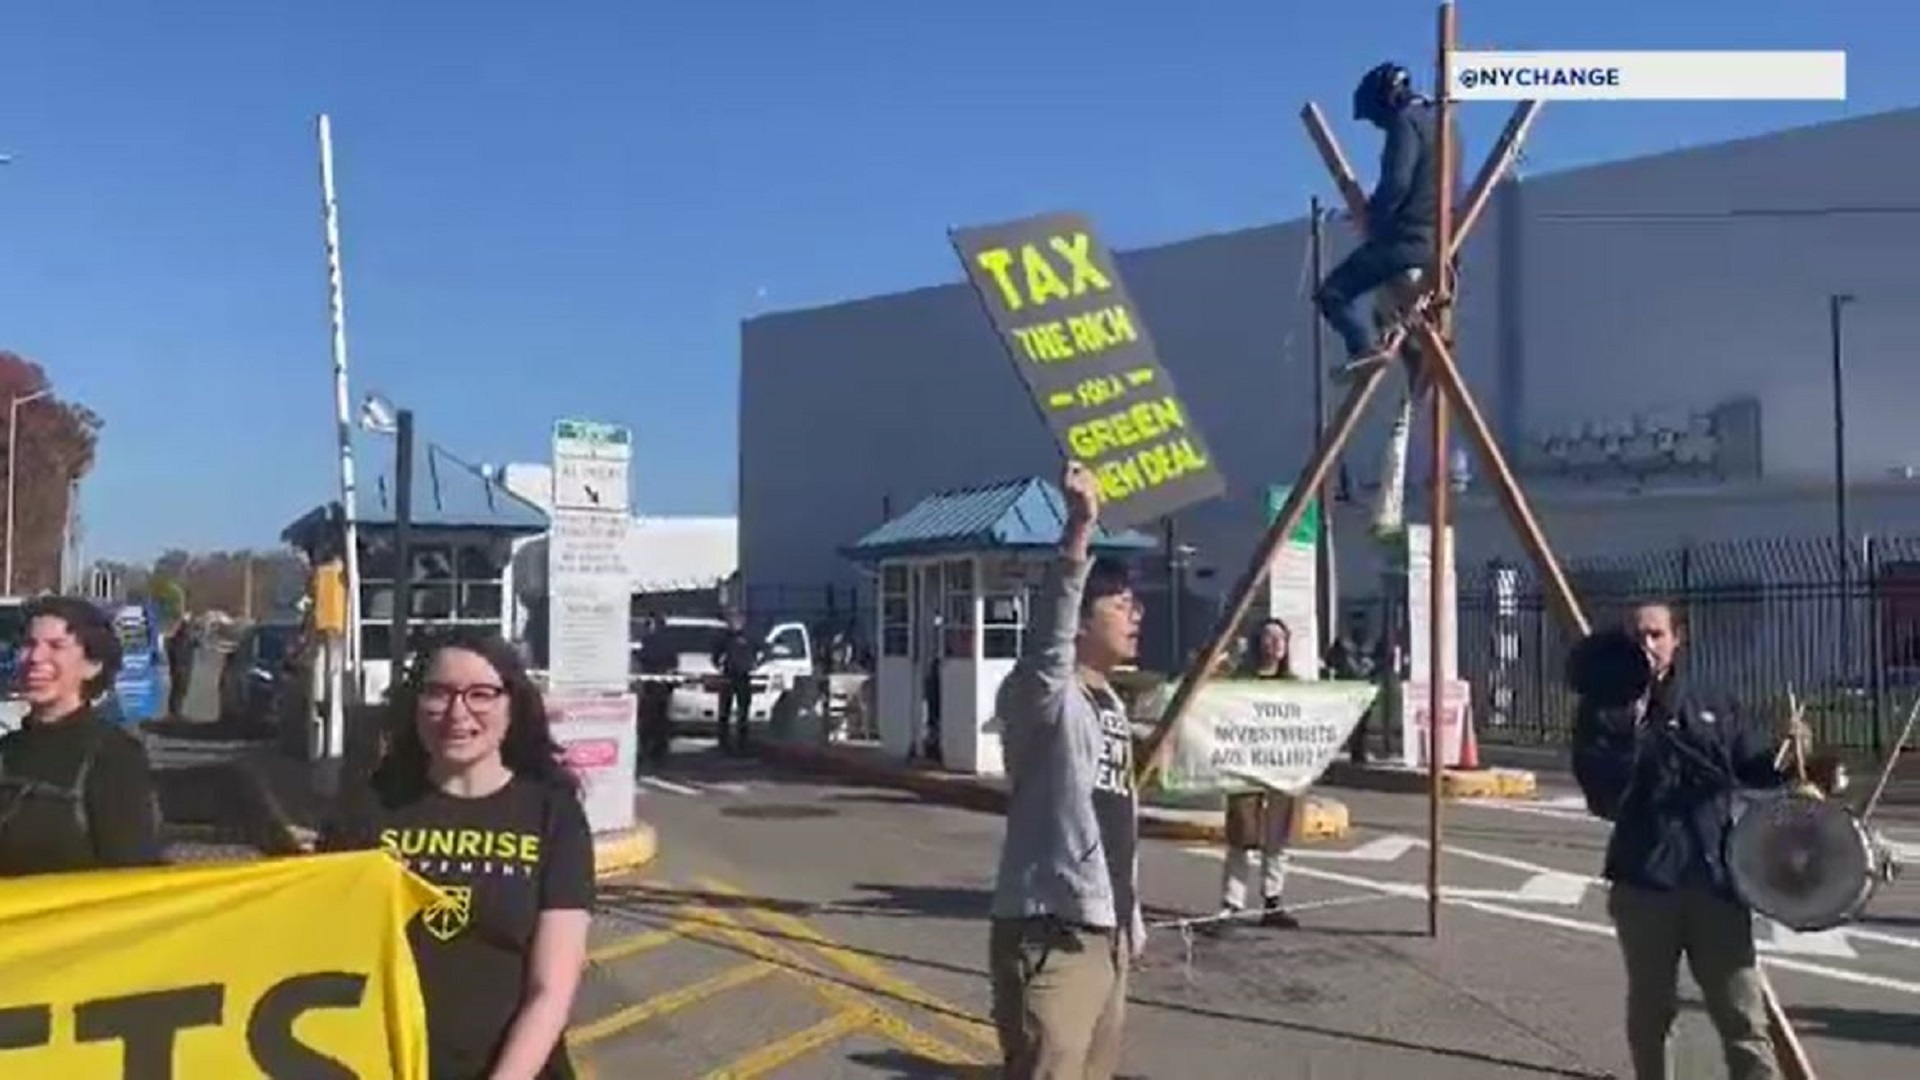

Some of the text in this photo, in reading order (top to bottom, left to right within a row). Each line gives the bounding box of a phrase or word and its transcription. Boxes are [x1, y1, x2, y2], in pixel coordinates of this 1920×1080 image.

[976, 232, 1112, 310] TAX
[1011, 304, 1138, 362] THE RICH
[1068, 396, 1184, 459] GREEN
[1138, 437, 1207, 484] DEAL
[380, 828, 541, 862] SUNRISE
